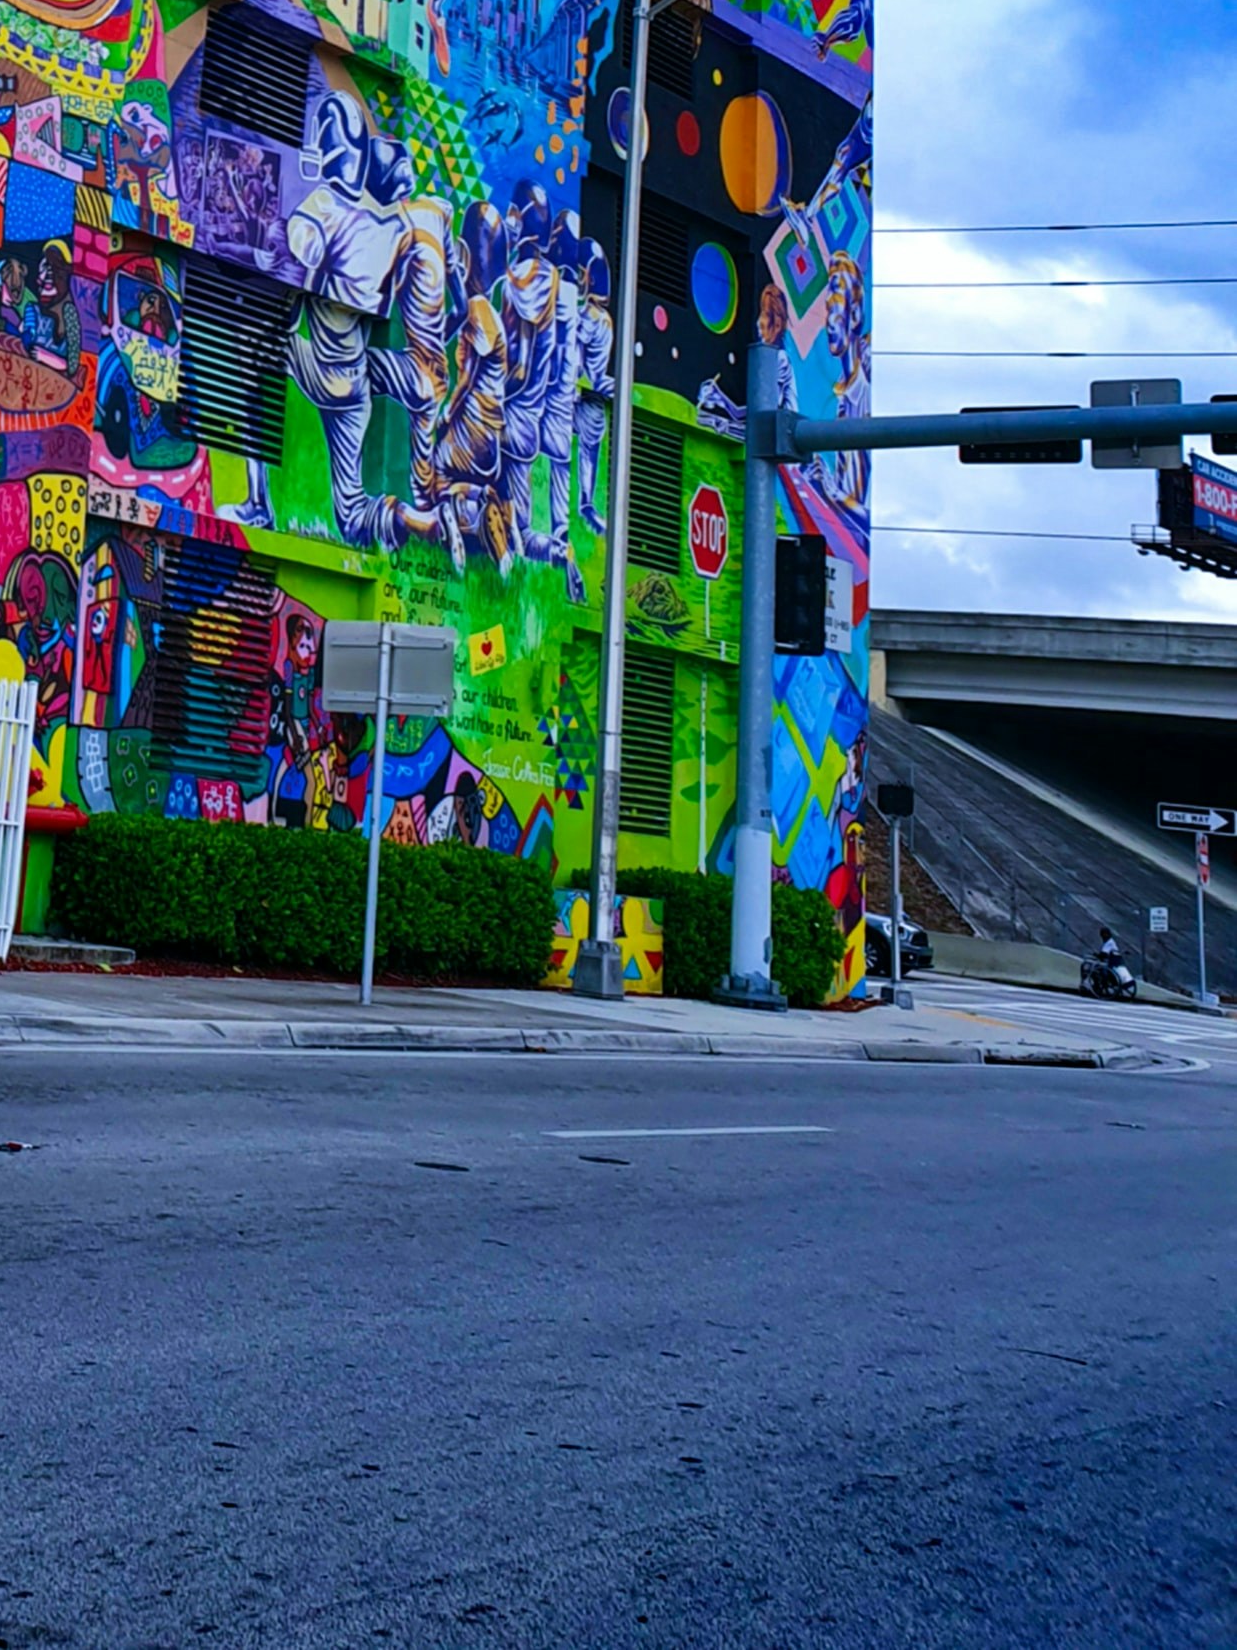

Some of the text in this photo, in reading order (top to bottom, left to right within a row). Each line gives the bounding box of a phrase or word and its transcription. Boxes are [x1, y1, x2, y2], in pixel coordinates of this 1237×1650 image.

[691, 508, 726, 555] STOP
[383, 582, 403, 600] are
[409, 588, 428, 604] our
[462, 689, 479, 703] our
[1168, 812, 1210, 824] ONE WAY
